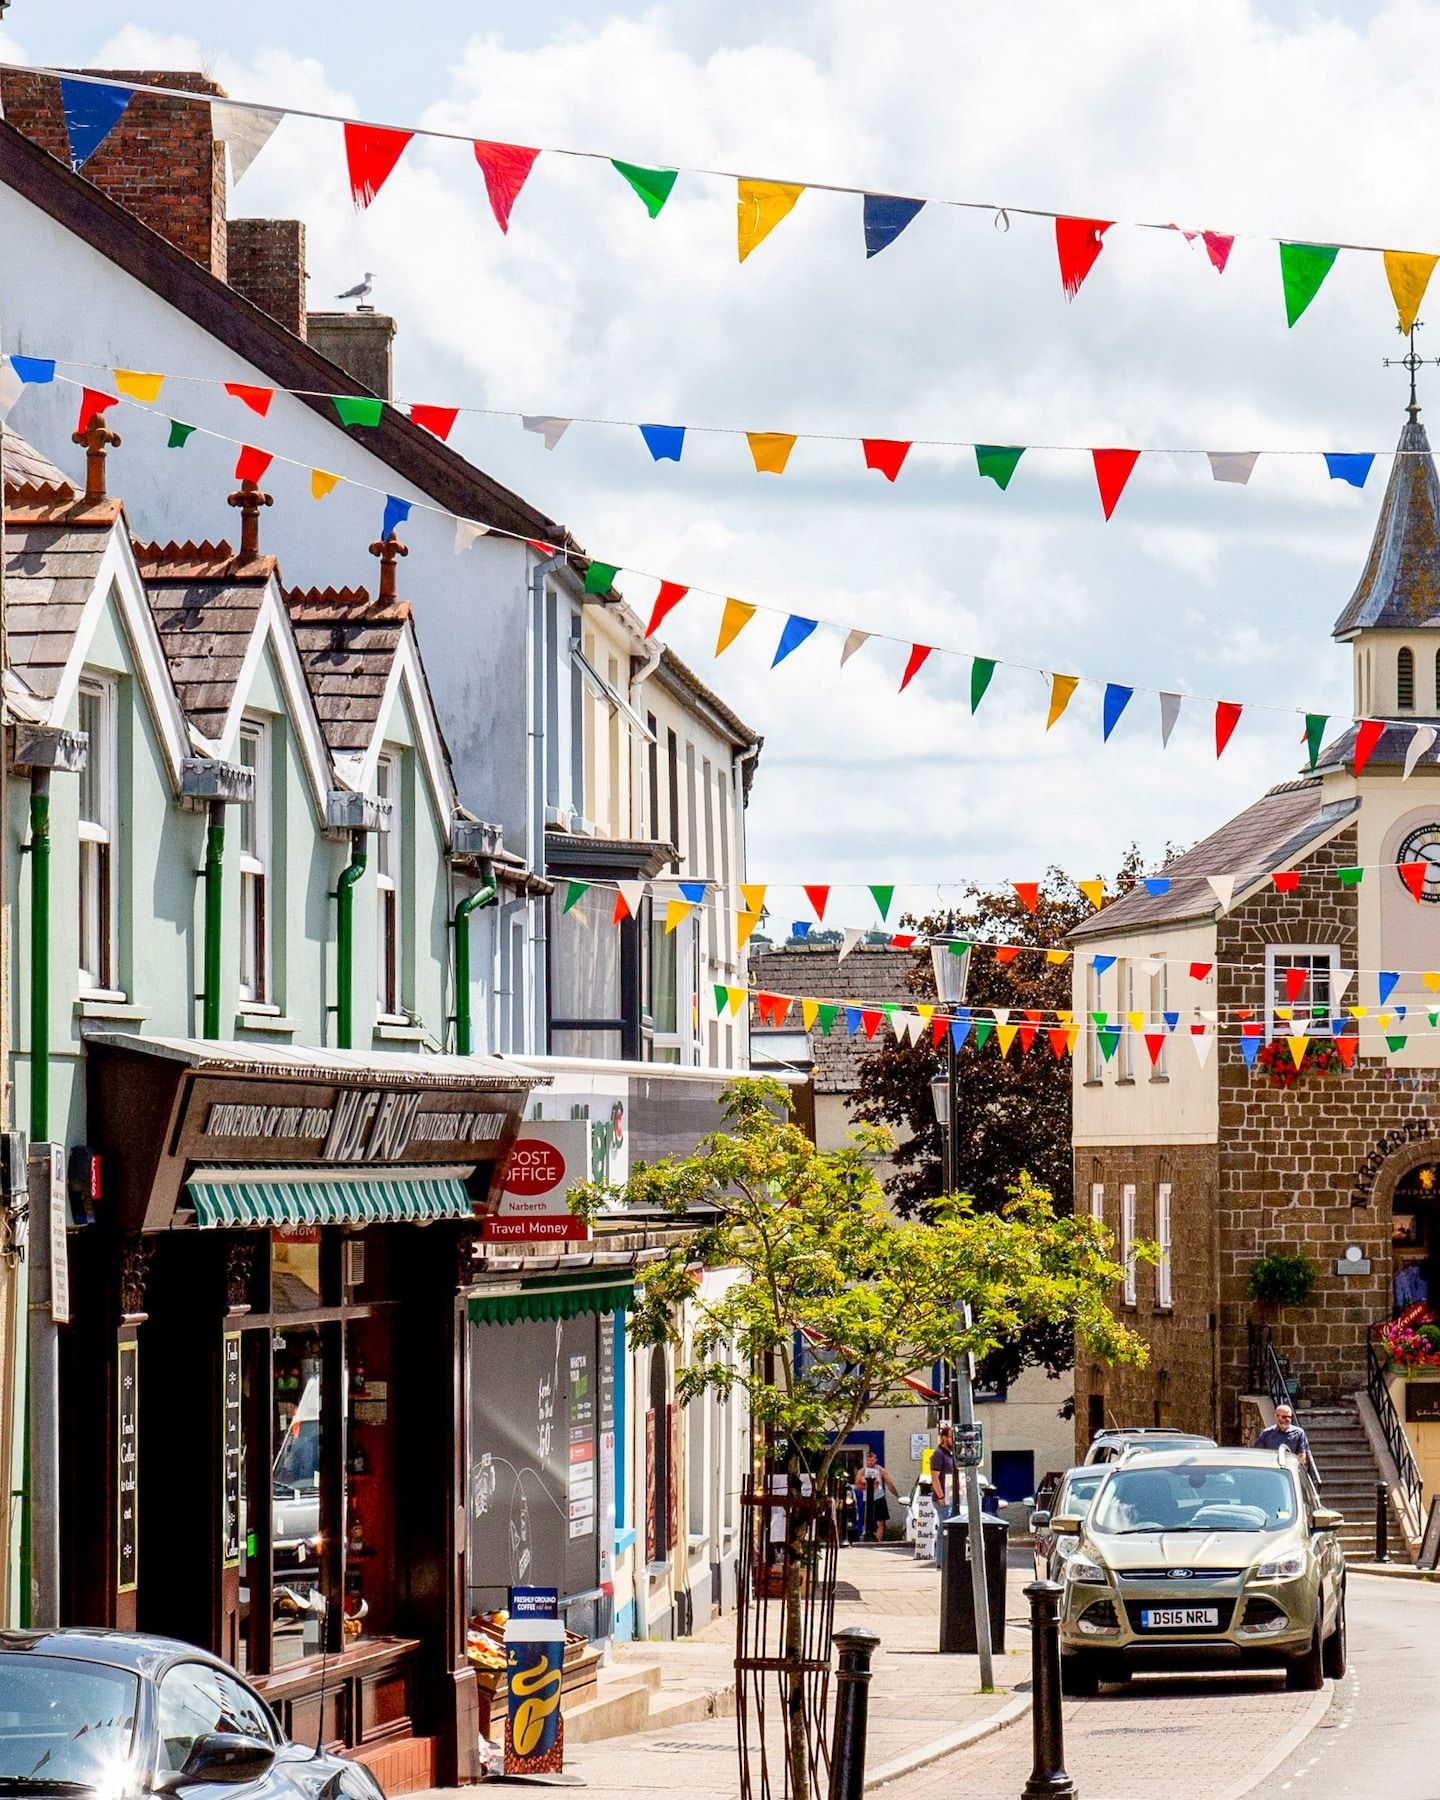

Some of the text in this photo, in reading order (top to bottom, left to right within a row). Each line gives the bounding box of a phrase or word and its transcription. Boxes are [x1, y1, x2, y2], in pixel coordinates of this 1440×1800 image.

[207, 1103, 333, 1139] PURVEYORS OF FINE FOODS
[324, 1090, 423, 1160] WISE BUYS
[459, 1113, 474, 1141] OF
[471, 1113, 508, 1144] QUALITY
[1351, 1119, 1430, 1209] NARBERTH
[508, 1202, 547, 1211] Narberth
[489, 1222, 568, 1236] Travel Money
[122, 1414, 134, 1435] Fresh
[120, 1443, 135, 1464] Coffee
[517, 1603, 536, 1611] COFFEE
[1153, 1610, 1213, 1625] DS15 NRL
